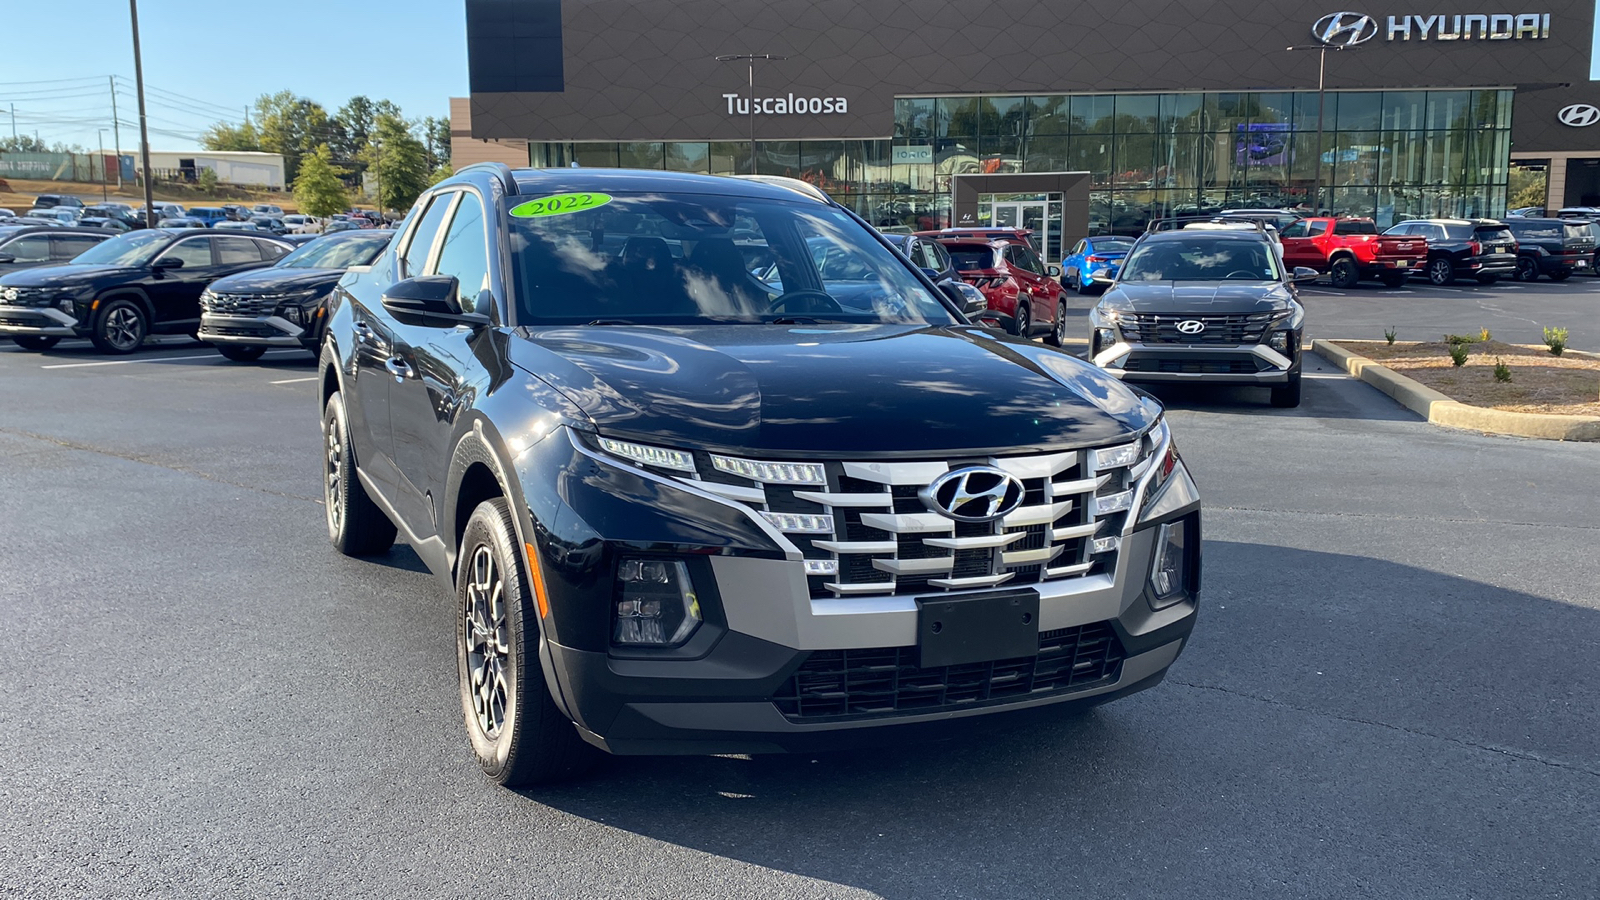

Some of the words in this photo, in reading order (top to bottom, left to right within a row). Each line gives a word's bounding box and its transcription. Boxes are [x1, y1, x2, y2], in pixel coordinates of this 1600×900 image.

[1386, 13, 1550, 41] HYUNDAI
[722, 92, 848, 115] Tuscaloosa
[530, 194, 594, 215] 2022
